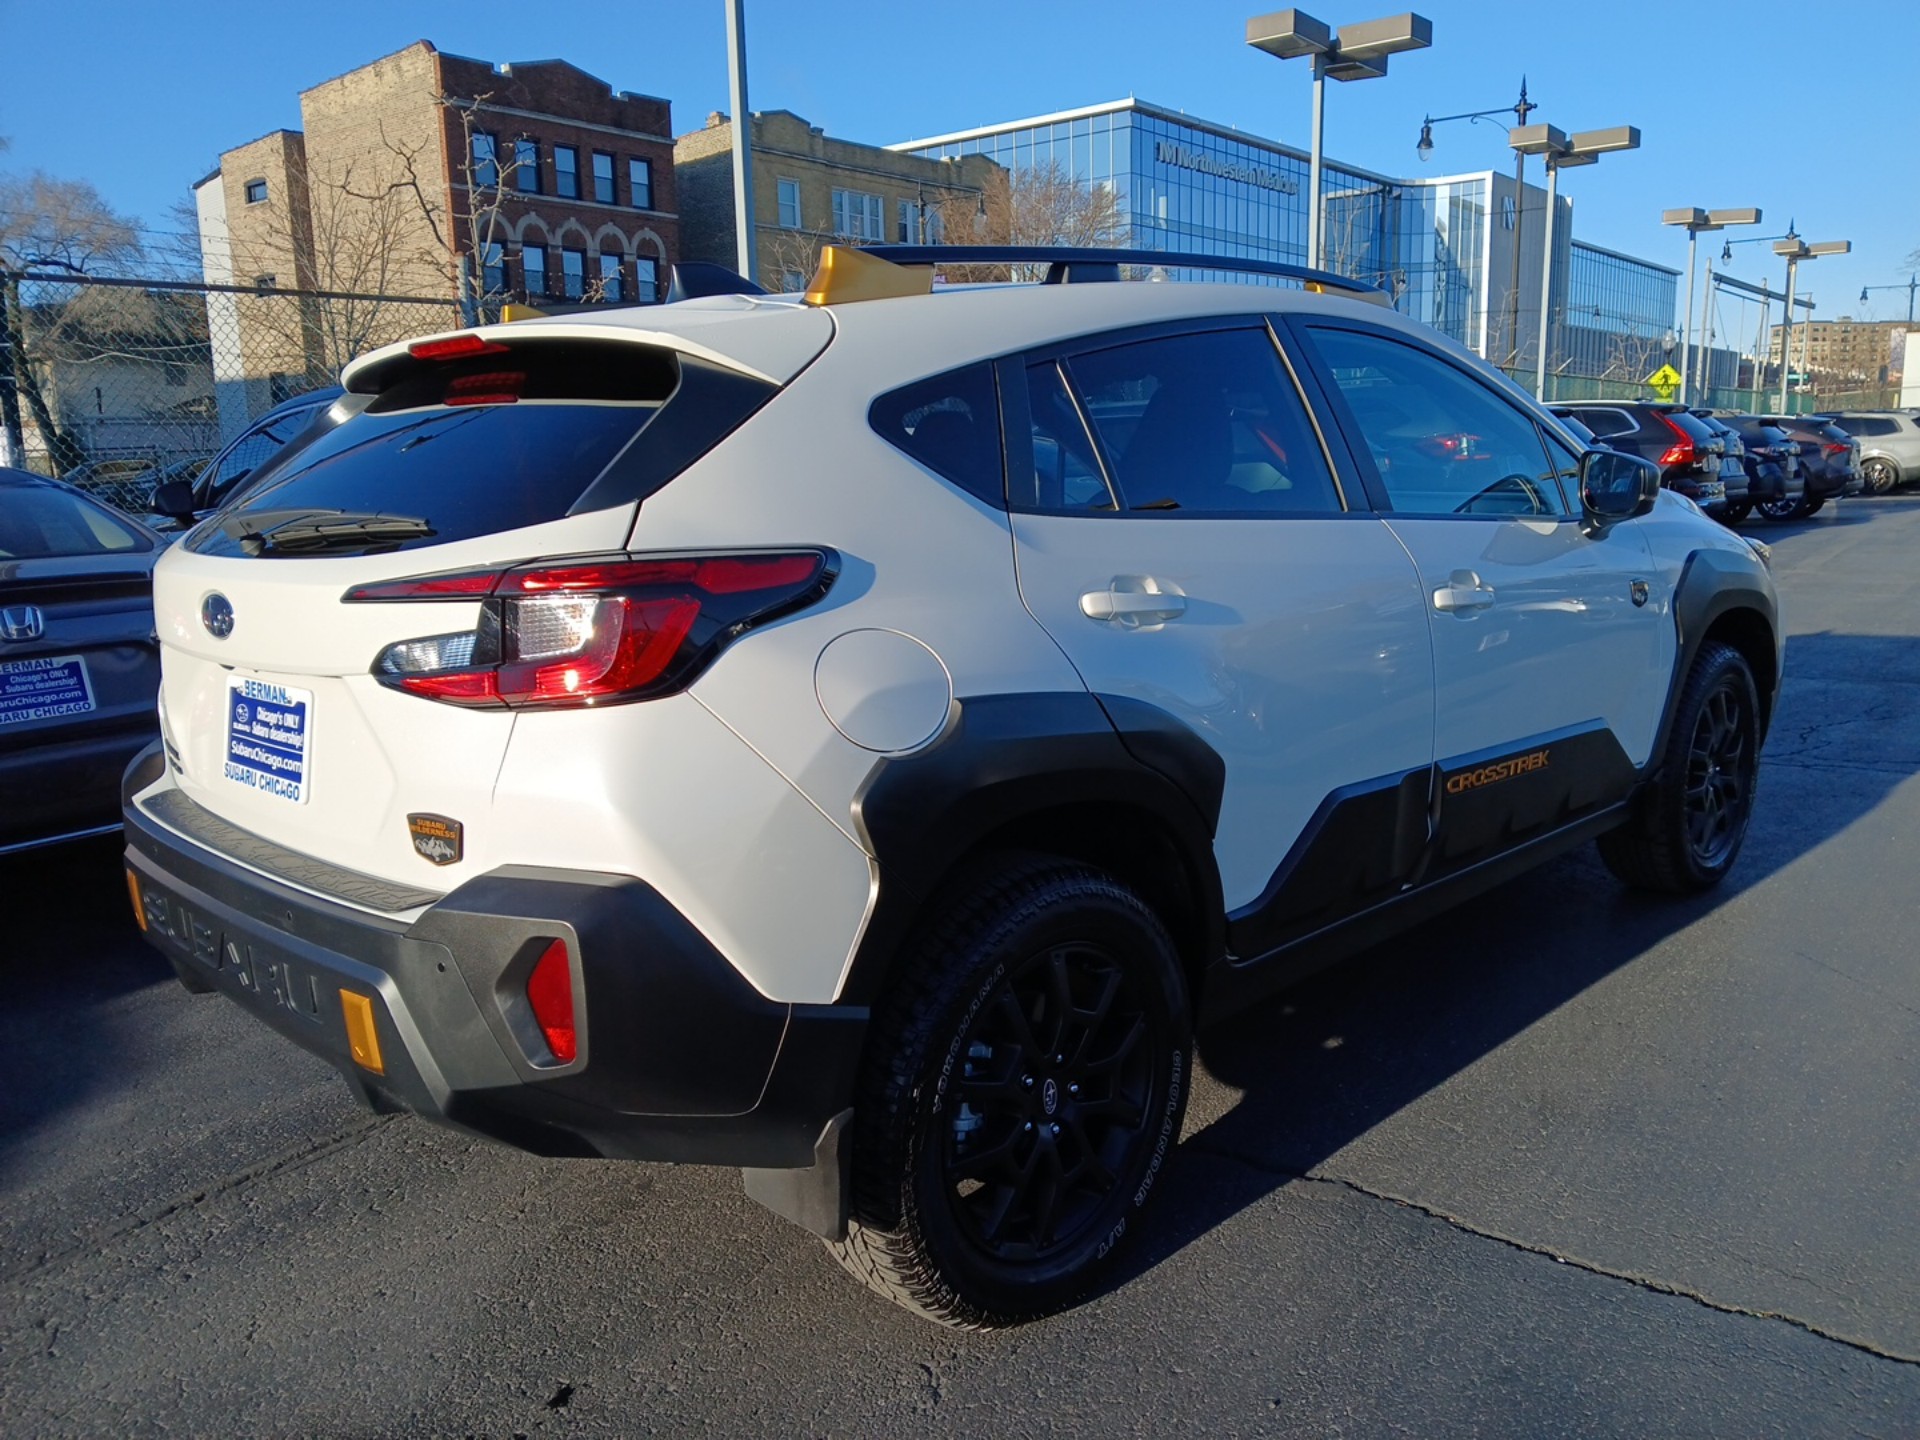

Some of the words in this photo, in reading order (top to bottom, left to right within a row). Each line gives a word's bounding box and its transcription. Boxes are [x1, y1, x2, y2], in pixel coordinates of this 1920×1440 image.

[1178, 149, 1257, 185] Northwestern
[1257, 168, 1299, 196] Medicine
[0, 658, 54, 673] ERMAN
[49, 669, 69, 679] ONLY
[0, 690, 82, 708] aruChicago.com
[5, 683, 34, 693] Subaru
[244, 679, 288, 704] BERMAN
[0, 711, 30, 723] ARU
[34, 702, 91, 718] CHICAGO
[231, 740, 302, 774] SubaruChicago.com
[224, 762, 257, 787] SUBARU
[259, 774, 300, 801] CHICAGO
[1446, 750, 1550, 794] CROSSTREK
[143, 891, 324, 1025] SUBARU
[1134, 1050, 1182, 1207] GEOLANDAR
